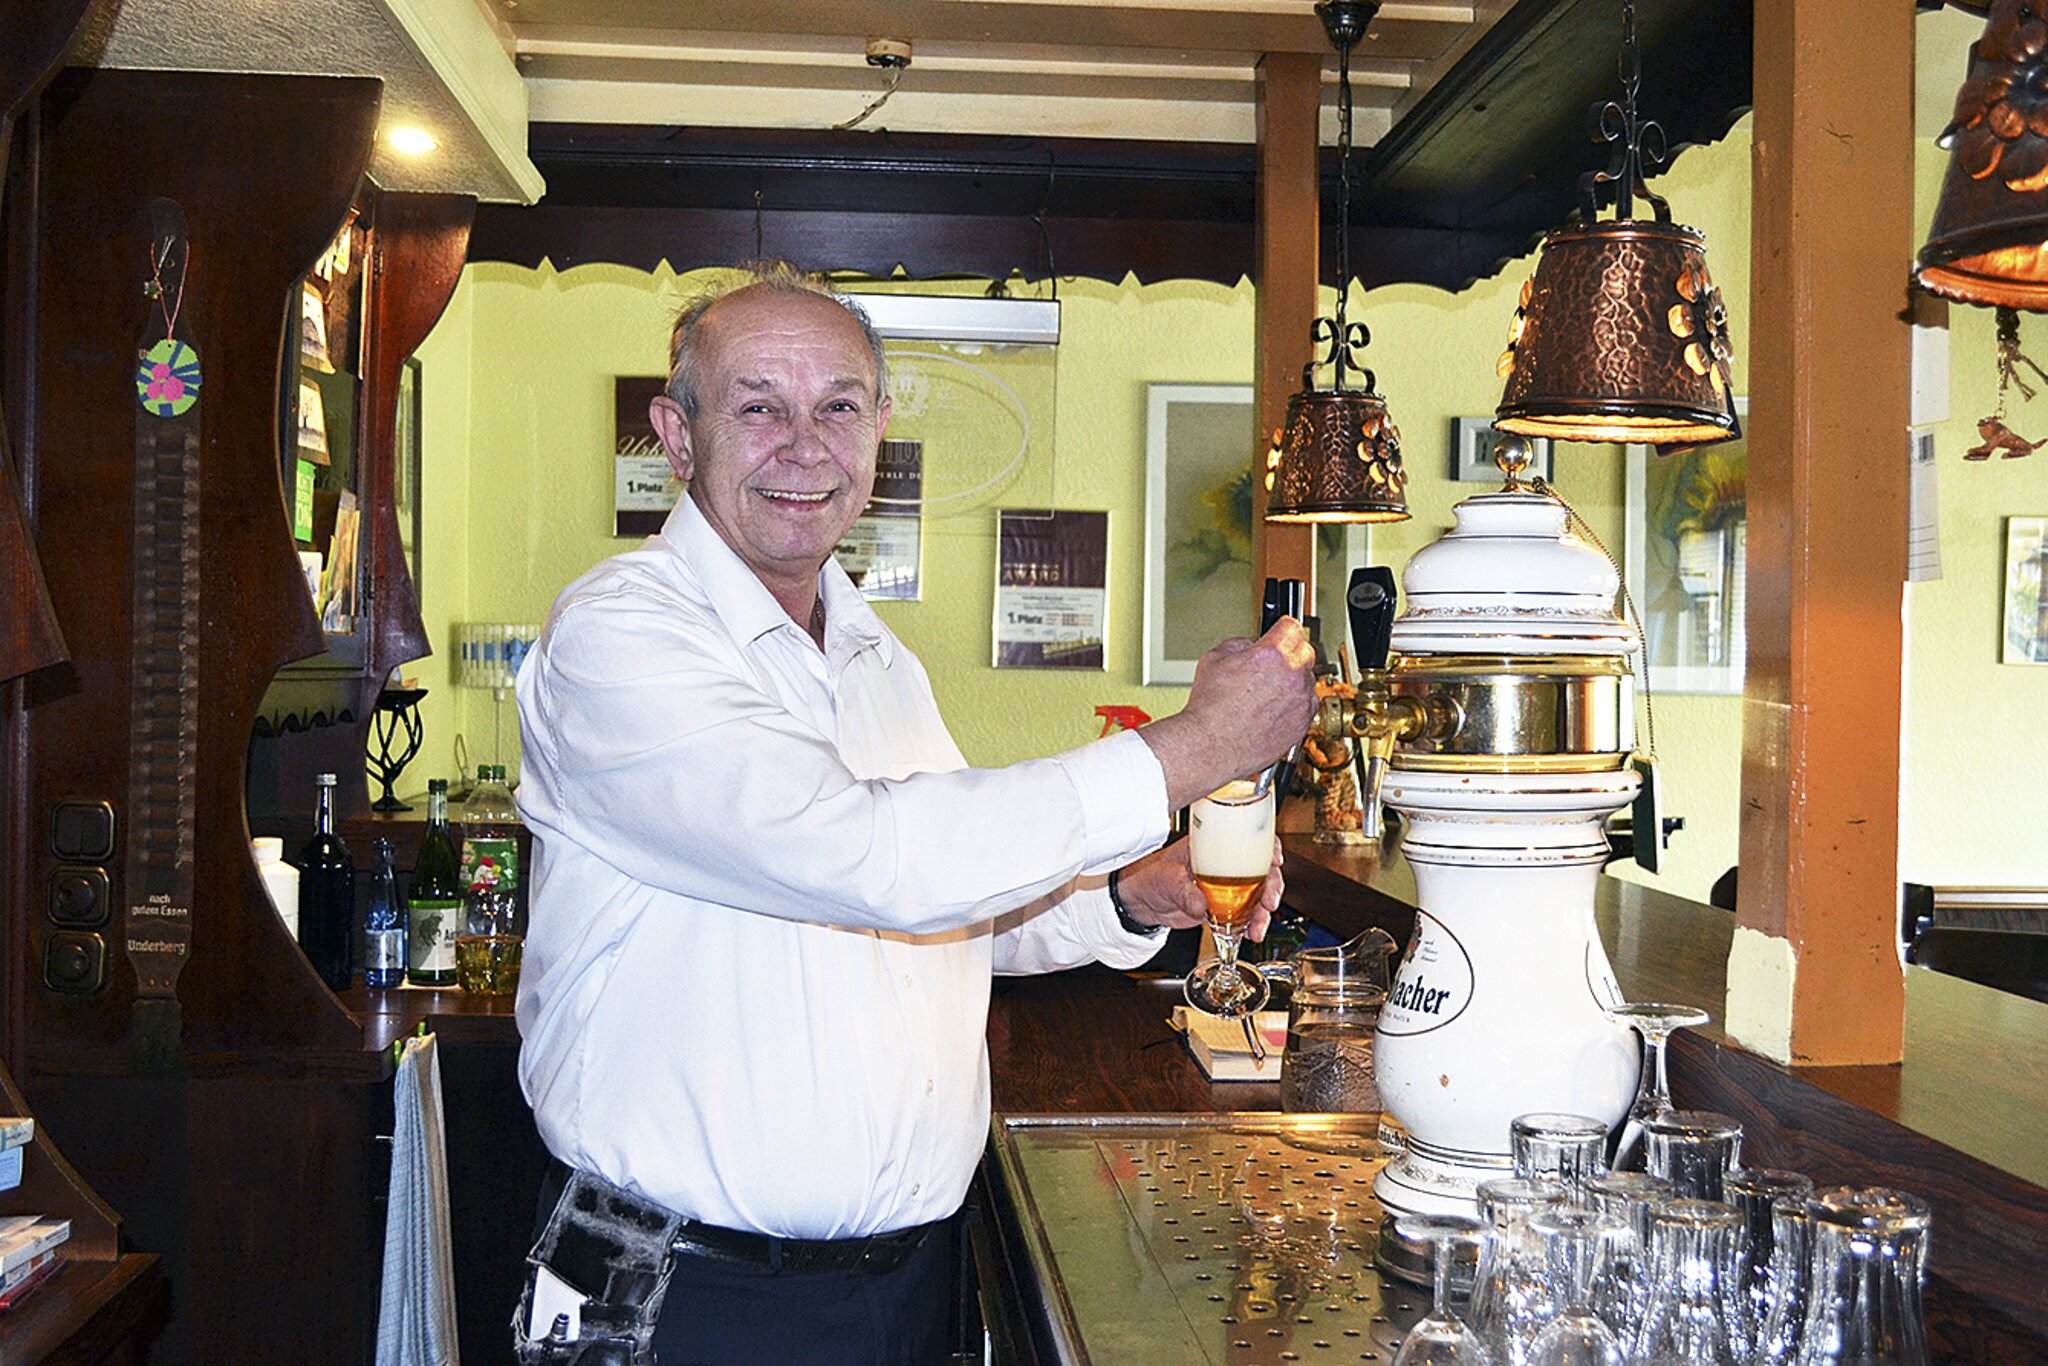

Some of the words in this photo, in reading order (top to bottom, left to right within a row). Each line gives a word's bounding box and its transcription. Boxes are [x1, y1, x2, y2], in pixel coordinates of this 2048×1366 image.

[618, 435, 667, 456] Urk
[160, 905, 188, 916] Essen
[127, 939, 186, 956] Underberg
